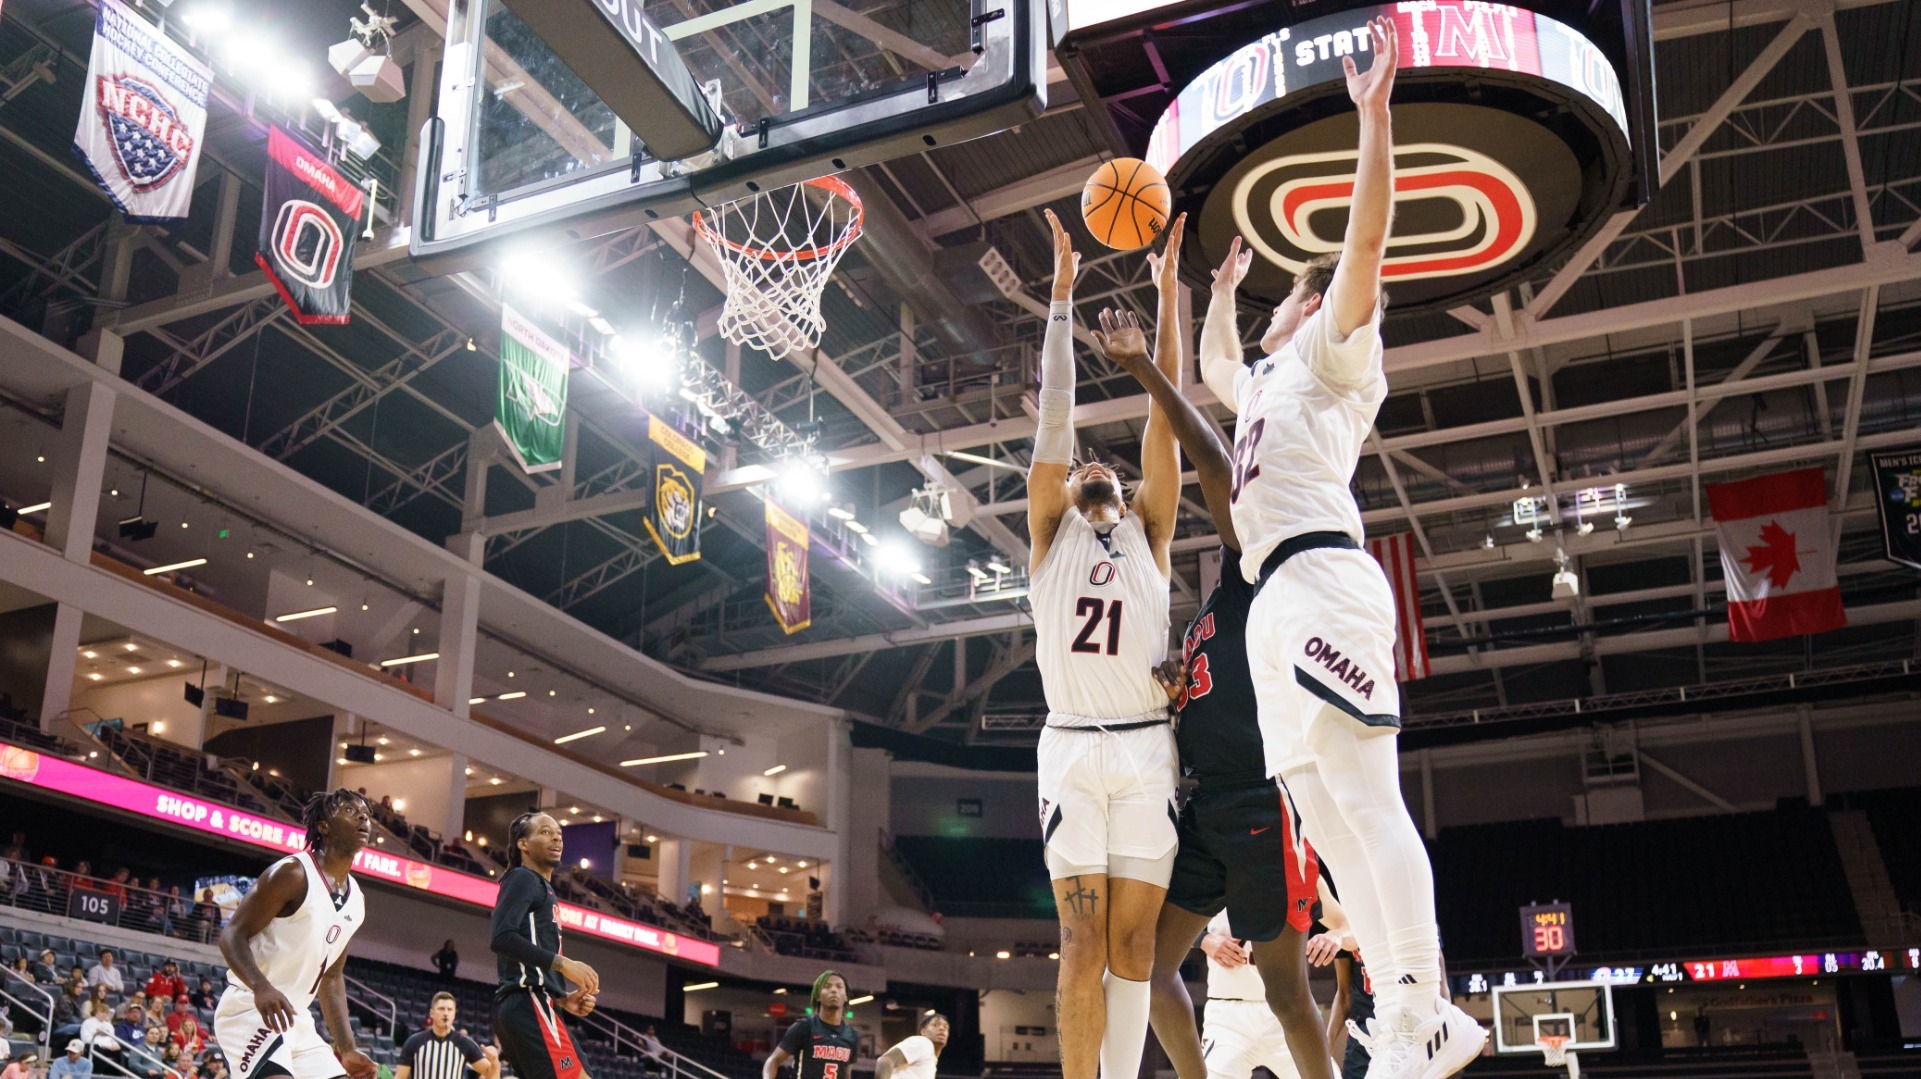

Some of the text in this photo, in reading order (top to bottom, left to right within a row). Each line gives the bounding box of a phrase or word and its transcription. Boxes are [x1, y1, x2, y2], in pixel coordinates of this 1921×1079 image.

[101, 79, 190, 160] NCHC
[295, 155, 336, 193] OMAHA
[1071, 597, 1122, 656] 21
[1183, 612, 1215, 667] ACU
[1304, 636, 1375, 701] OMAHA
[156, 794, 207, 822] SHOP
[210, 810, 224, 829] &
[229, 814, 283, 844] SCORE
[82, 895, 109, 915] 105
[1534, 926, 1564, 952] 30
[1651, 963, 1677, 977] 4:41
[1694, 963, 1715, 978] 21
[240, 1028, 272, 1073] OMAHA
[812, 1045, 851, 1062] MACU
[822, 1062, 839, 1079] 5
